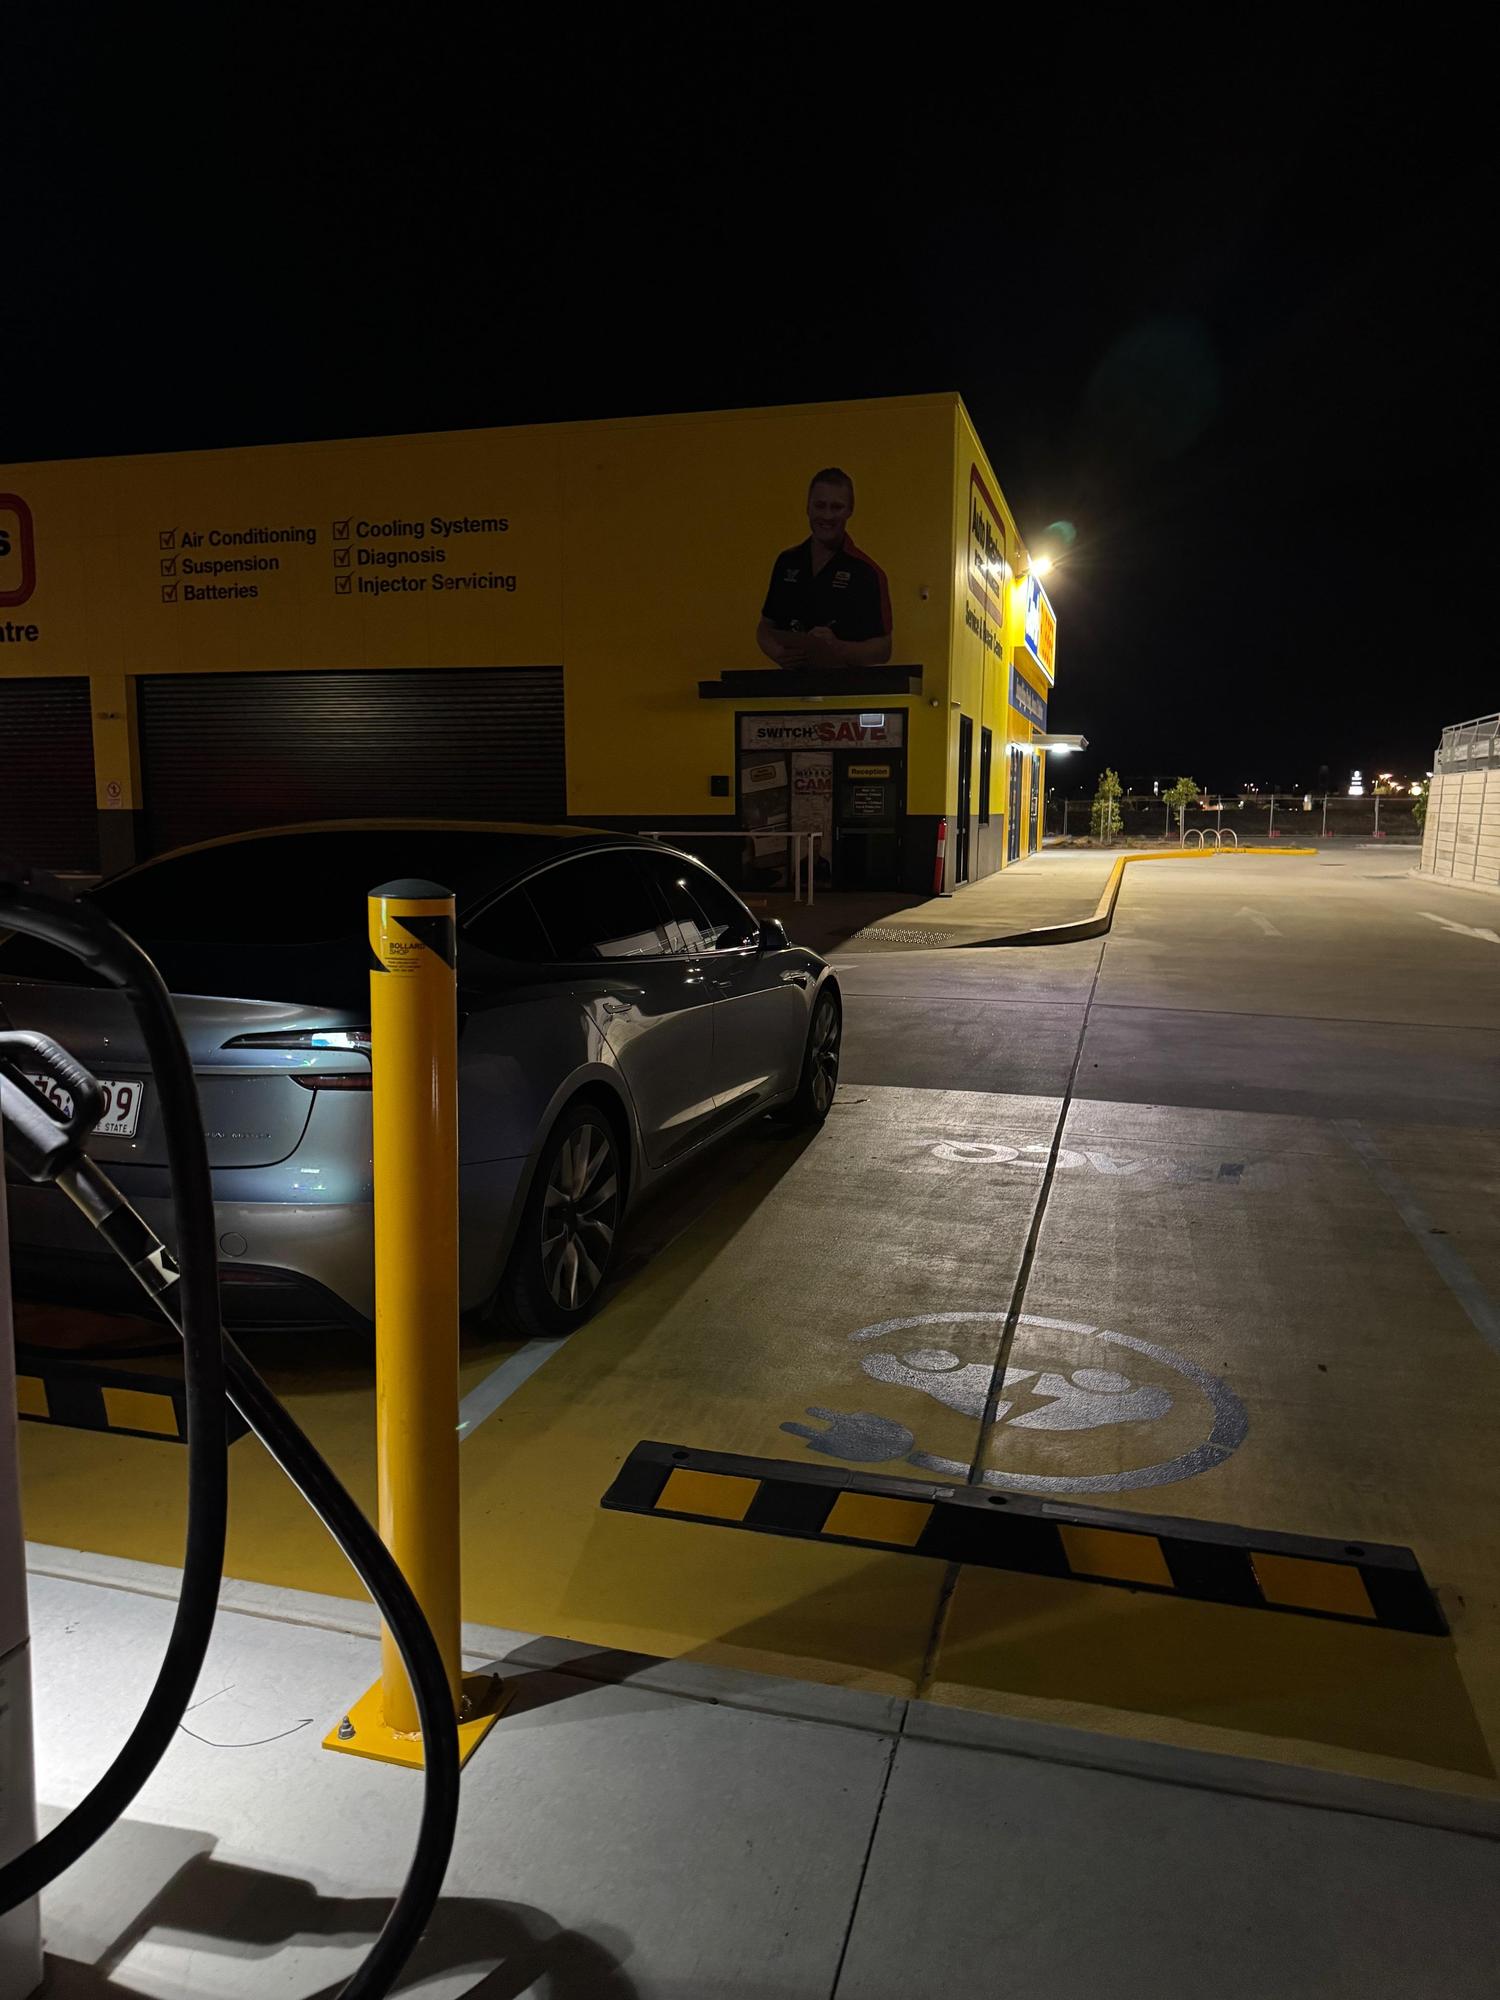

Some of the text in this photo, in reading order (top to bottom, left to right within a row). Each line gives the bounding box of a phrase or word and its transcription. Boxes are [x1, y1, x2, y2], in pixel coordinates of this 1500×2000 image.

[181, 526, 317, 548] Air Conditioning
[356, 517, 509, 539] Cooling Systems
[182, 555, 279, 576] Suspension
[357, 546, 446, 568] Diagnosis
[184, 583, 259, 601] Batteries
[358, 572, 516, 596] Injector Servicing
[757, 722, 887, 741] SWITCH SAVE
[851, 768, 888, 776] Reception
[105, 1122, 127, 1133] STATE
